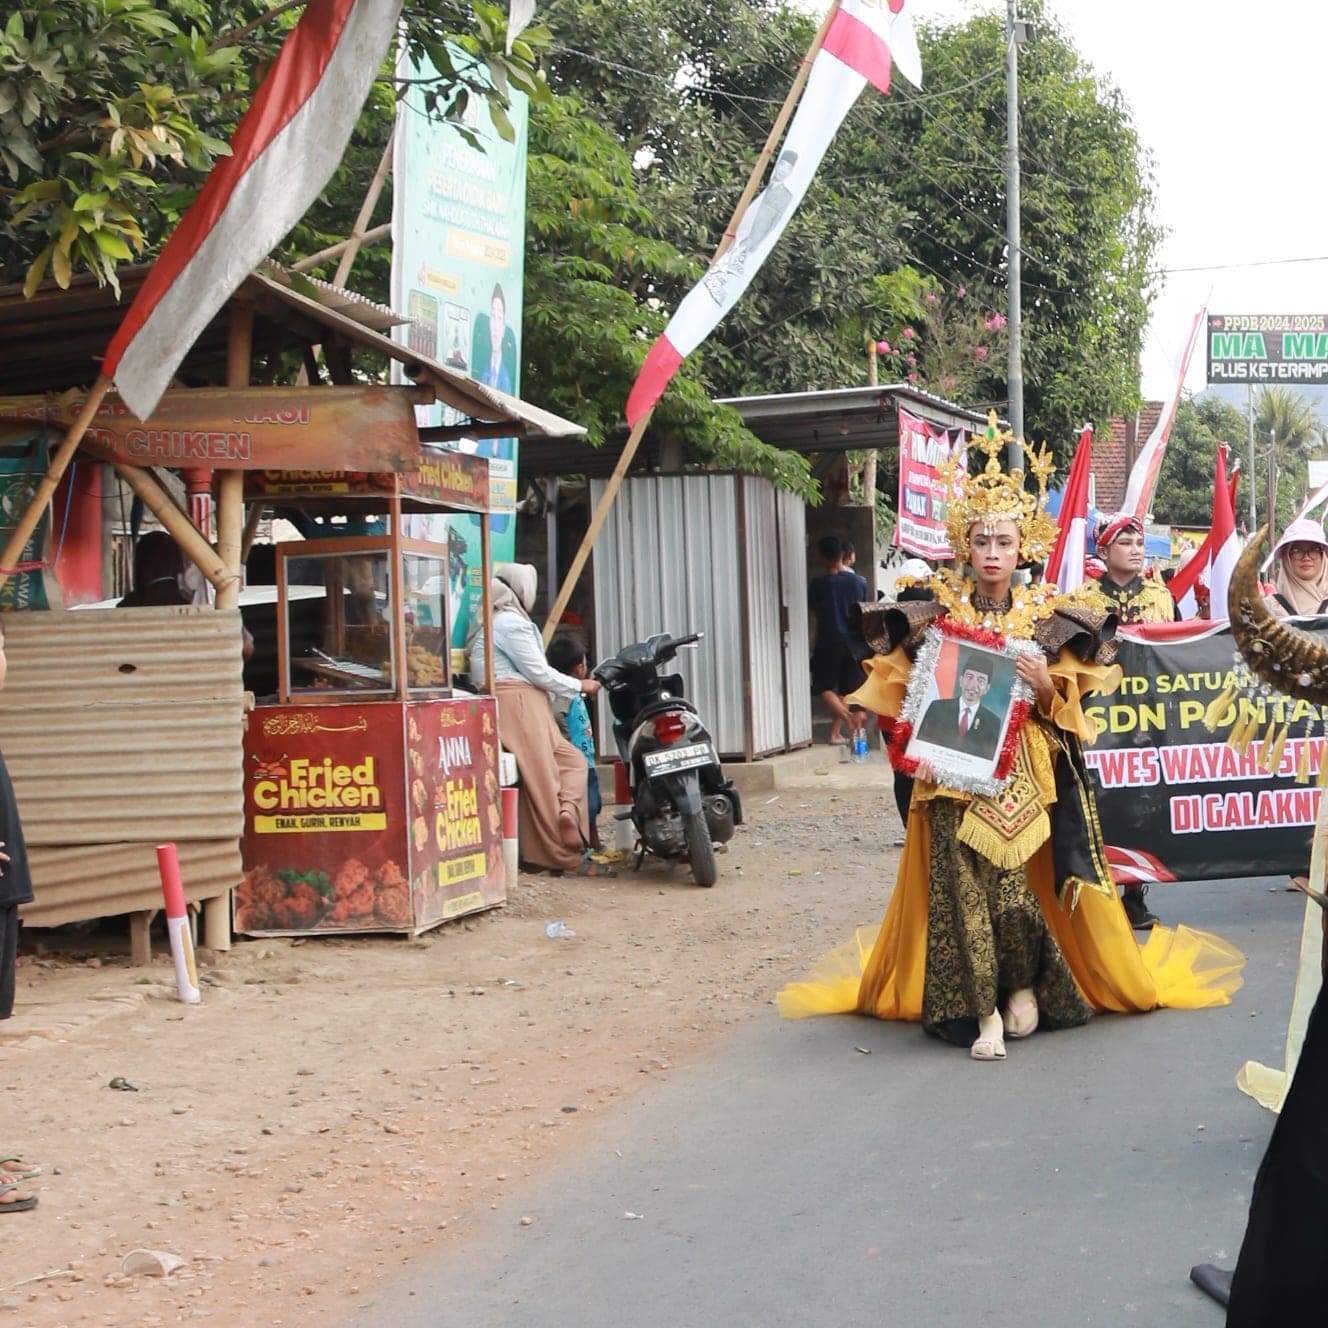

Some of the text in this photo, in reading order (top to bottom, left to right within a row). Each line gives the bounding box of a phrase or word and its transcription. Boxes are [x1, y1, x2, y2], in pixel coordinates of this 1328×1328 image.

[1259, 315, 1325, 331] 2024/2025
[1211, 332, 1268, 360] MA
[1211, 363, 1247, 379] PLUS
[125, 429, 252, 460] CHIKEN
[1156, 671, 1260, 693] SATUAN
[1084, 702, 1167, 734] SDN
[438, 736, 473, 775] ANNA
[290, 756, 375, 788] Fried
[253, 780, 380, 810] Chicken
[446, 775, 479, 819] Fried
[1174, 796, 1200, 831] DI
[436, 809, 483, 852] Chicken
